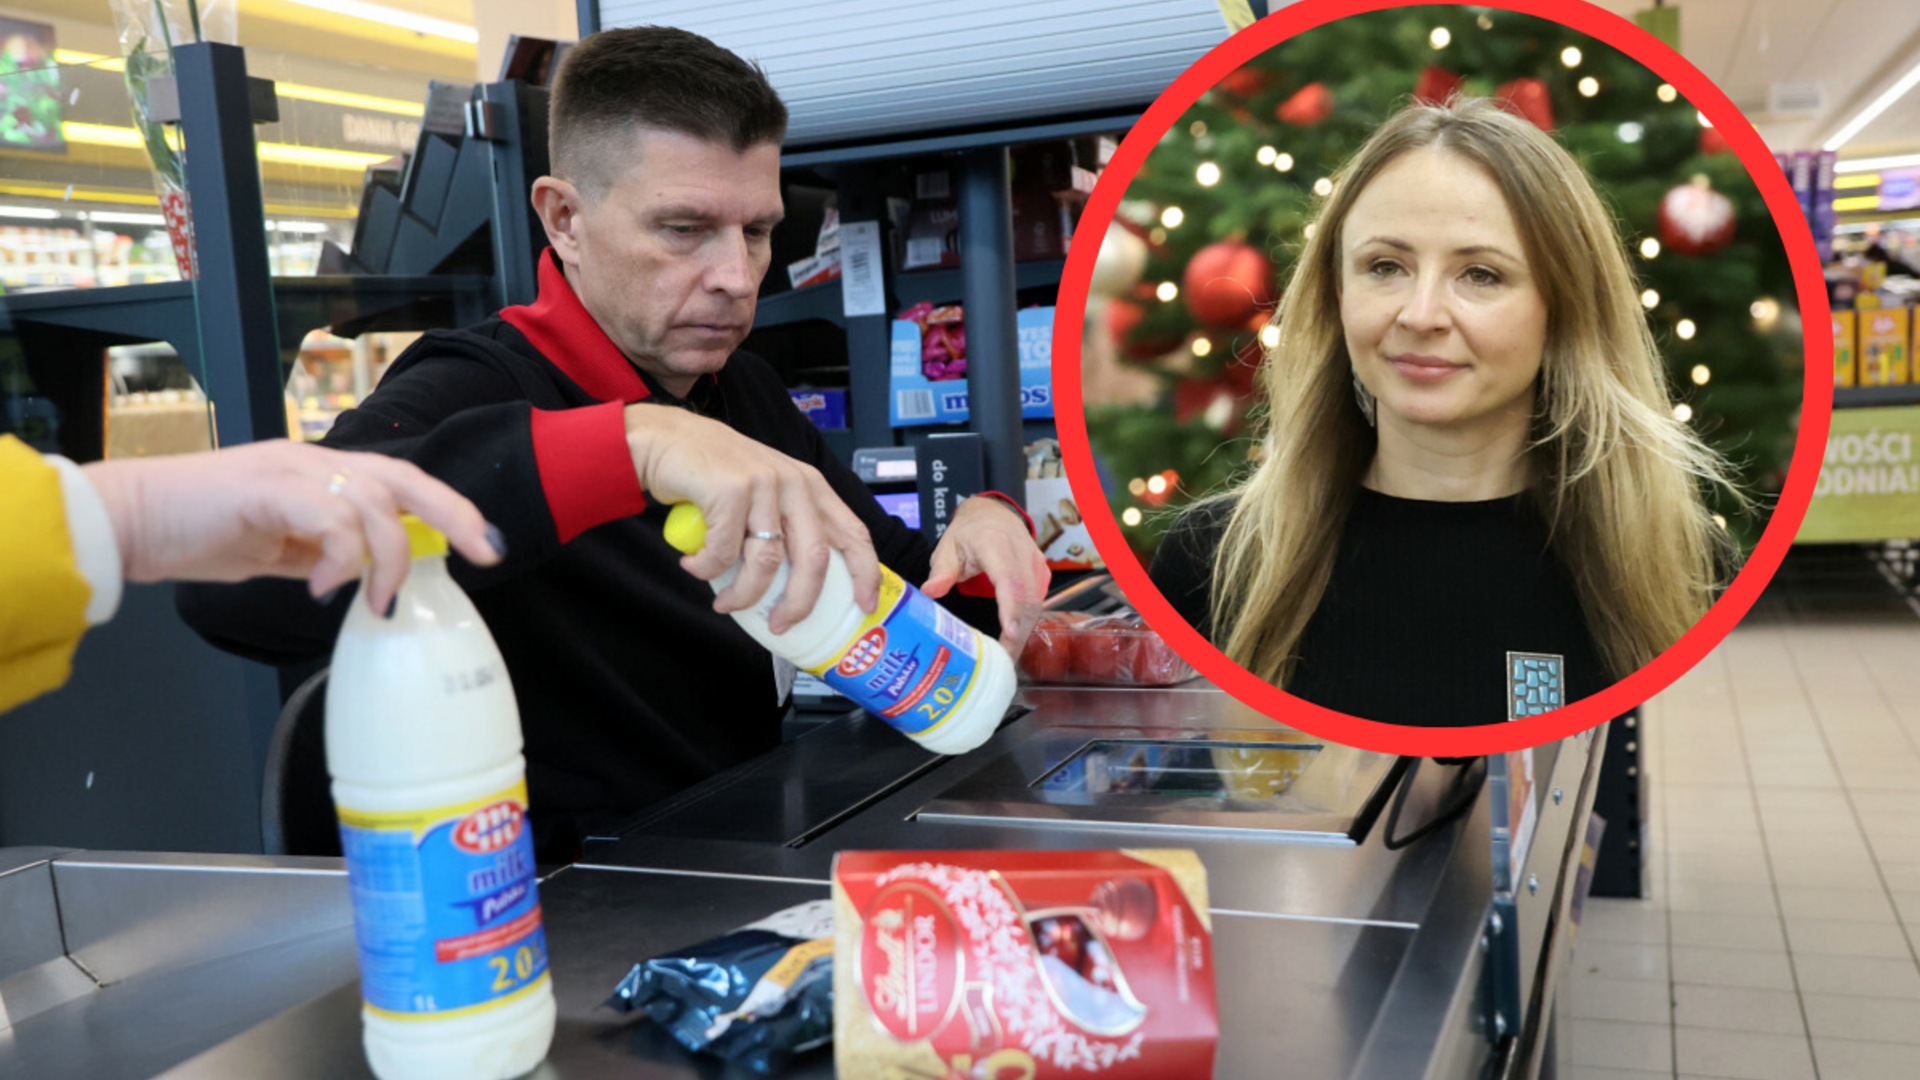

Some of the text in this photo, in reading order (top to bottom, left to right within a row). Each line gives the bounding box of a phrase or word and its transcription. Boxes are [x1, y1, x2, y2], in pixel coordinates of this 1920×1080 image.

[932, 459, 948, 482] do
[934, 487, 949, 518] kas
[866, 648, 908, 690] milk
[469, 848, 526, 892] milk
[914, 914, 938, 1013] LINDOR
